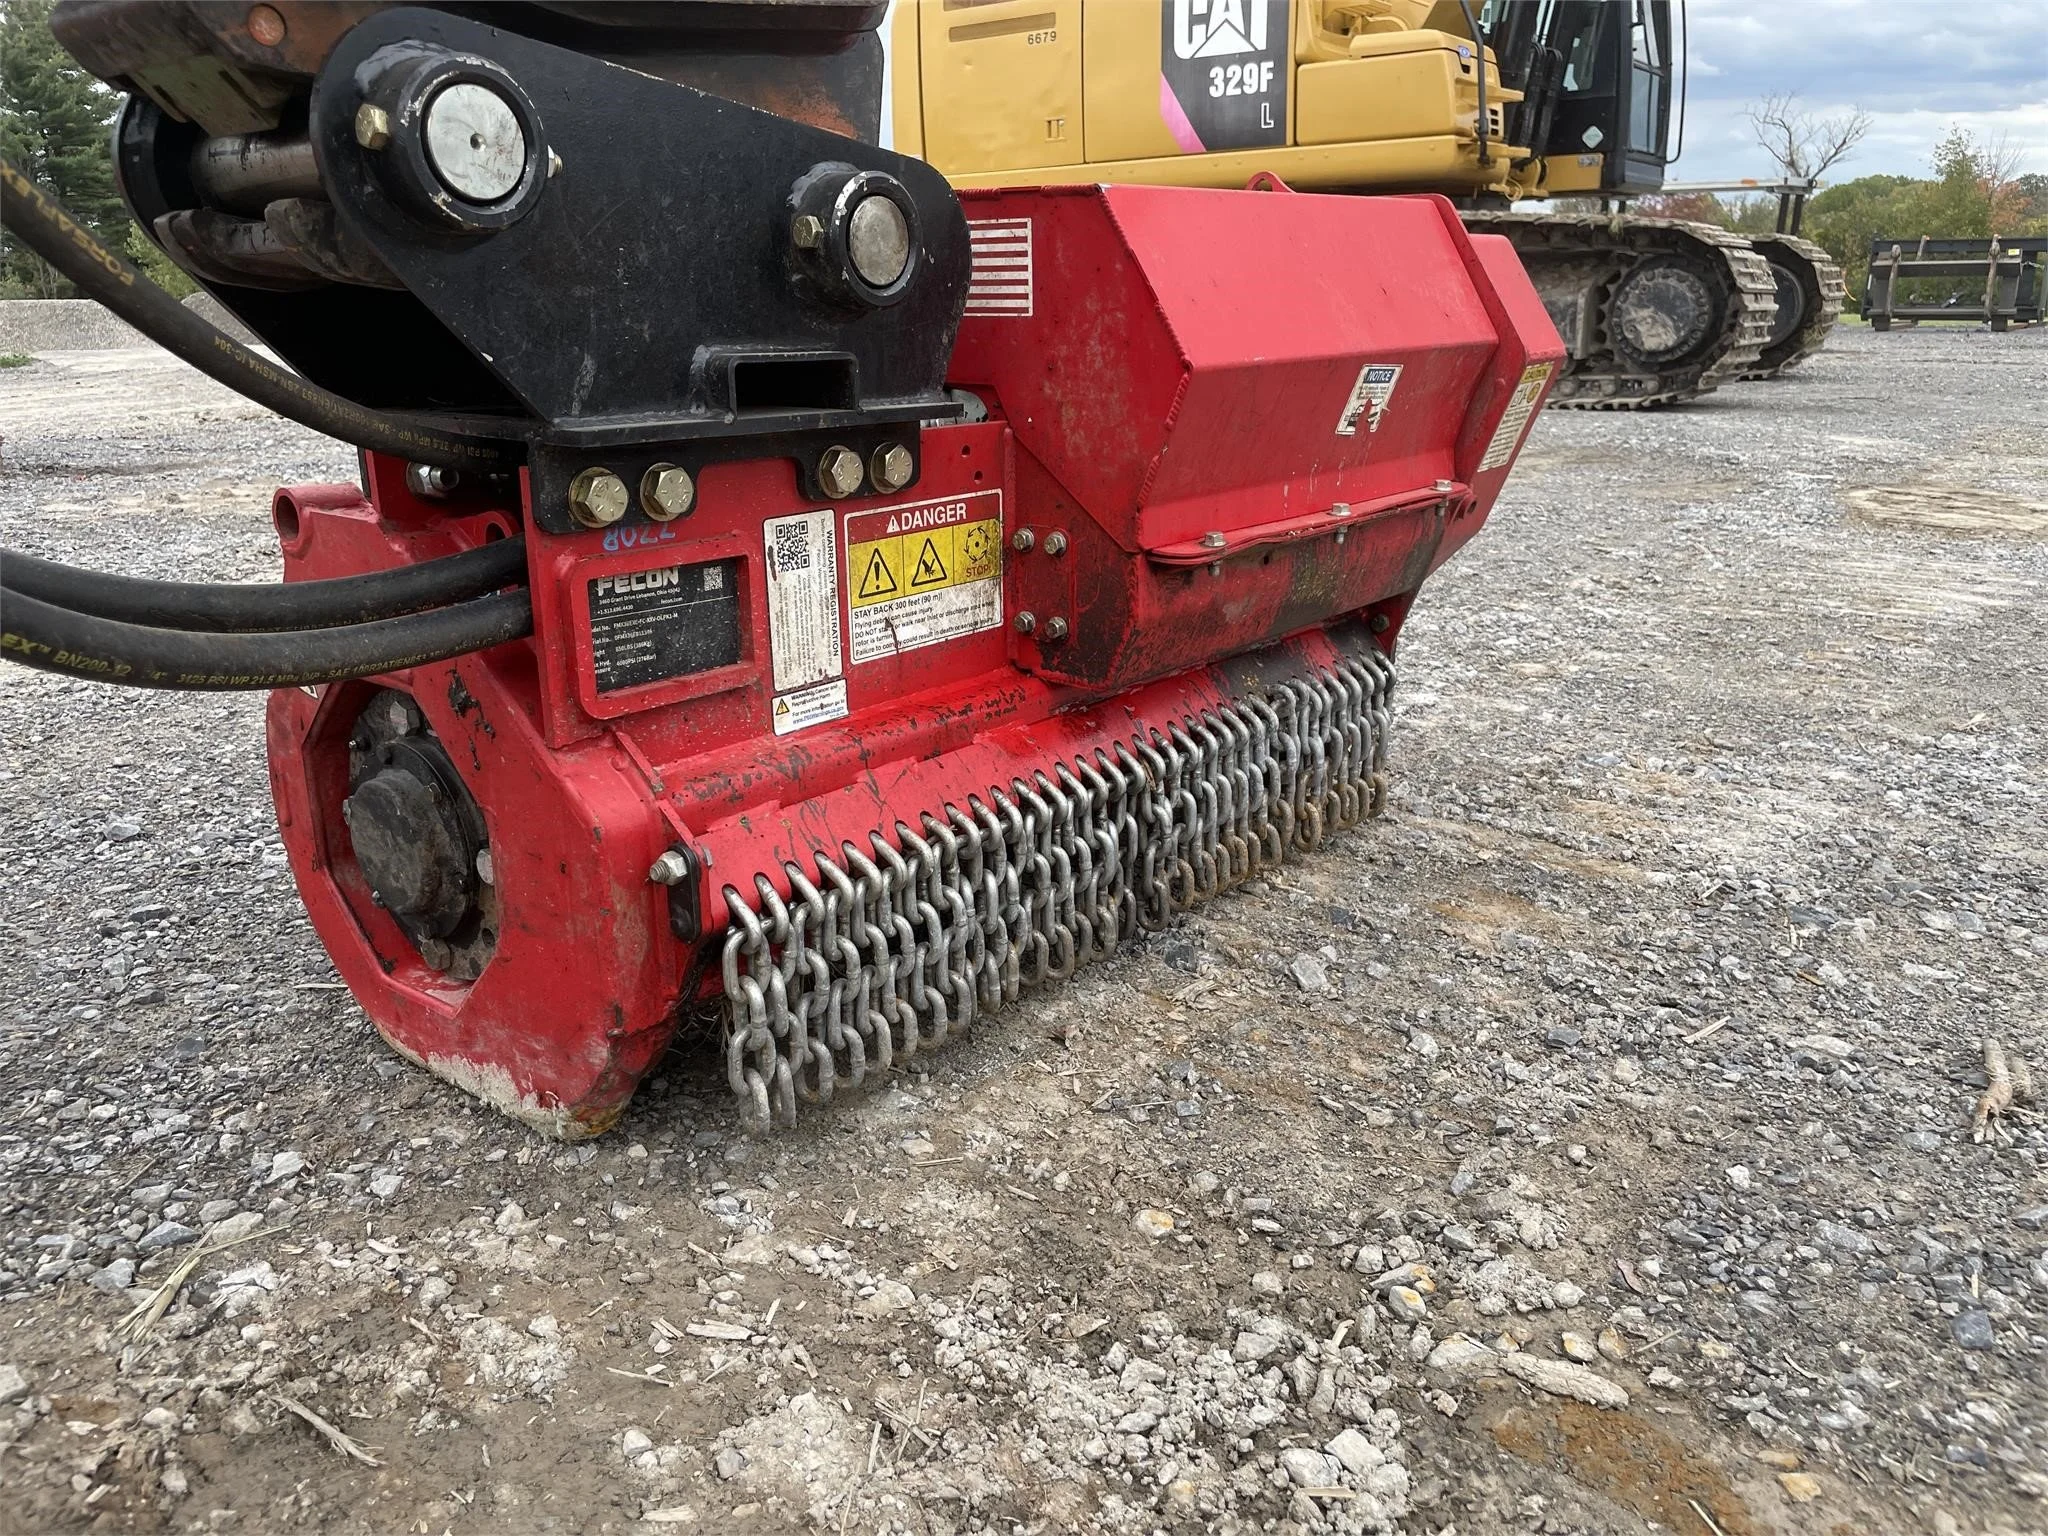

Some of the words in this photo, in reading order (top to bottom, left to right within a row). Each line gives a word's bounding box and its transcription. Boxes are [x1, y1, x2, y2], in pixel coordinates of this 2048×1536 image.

[1027, 31, 1057, 45] 6679
[1209, 61, 1275, 97] 329F
[1261, 102, 1275, 128] L
[1367, 370, 1392, 381] NOTICE
[901, 502, 967, 531] DANGER
[826, 529, 835, 585] WARRANTY
[597, 566, 680, 597] FECON
[854, 608, 872, 620] STAY
[873, 603, 894, 615] BACK
[895, 600, 907, 610] 300
[908, 597, 920, 607] feet
[854, 620, 872, 630] Flying
[901, 610, 917, 618] cause
[829, 586, 839, 657] REGISTRATION
[855, 630, 864, 639] DO
[865, 627, 877, 636] NOT
[876, 632, 893, 642] turnin
[856, 645, 875, 656] Failure
[53, 650, 132, 677] BN200-12
